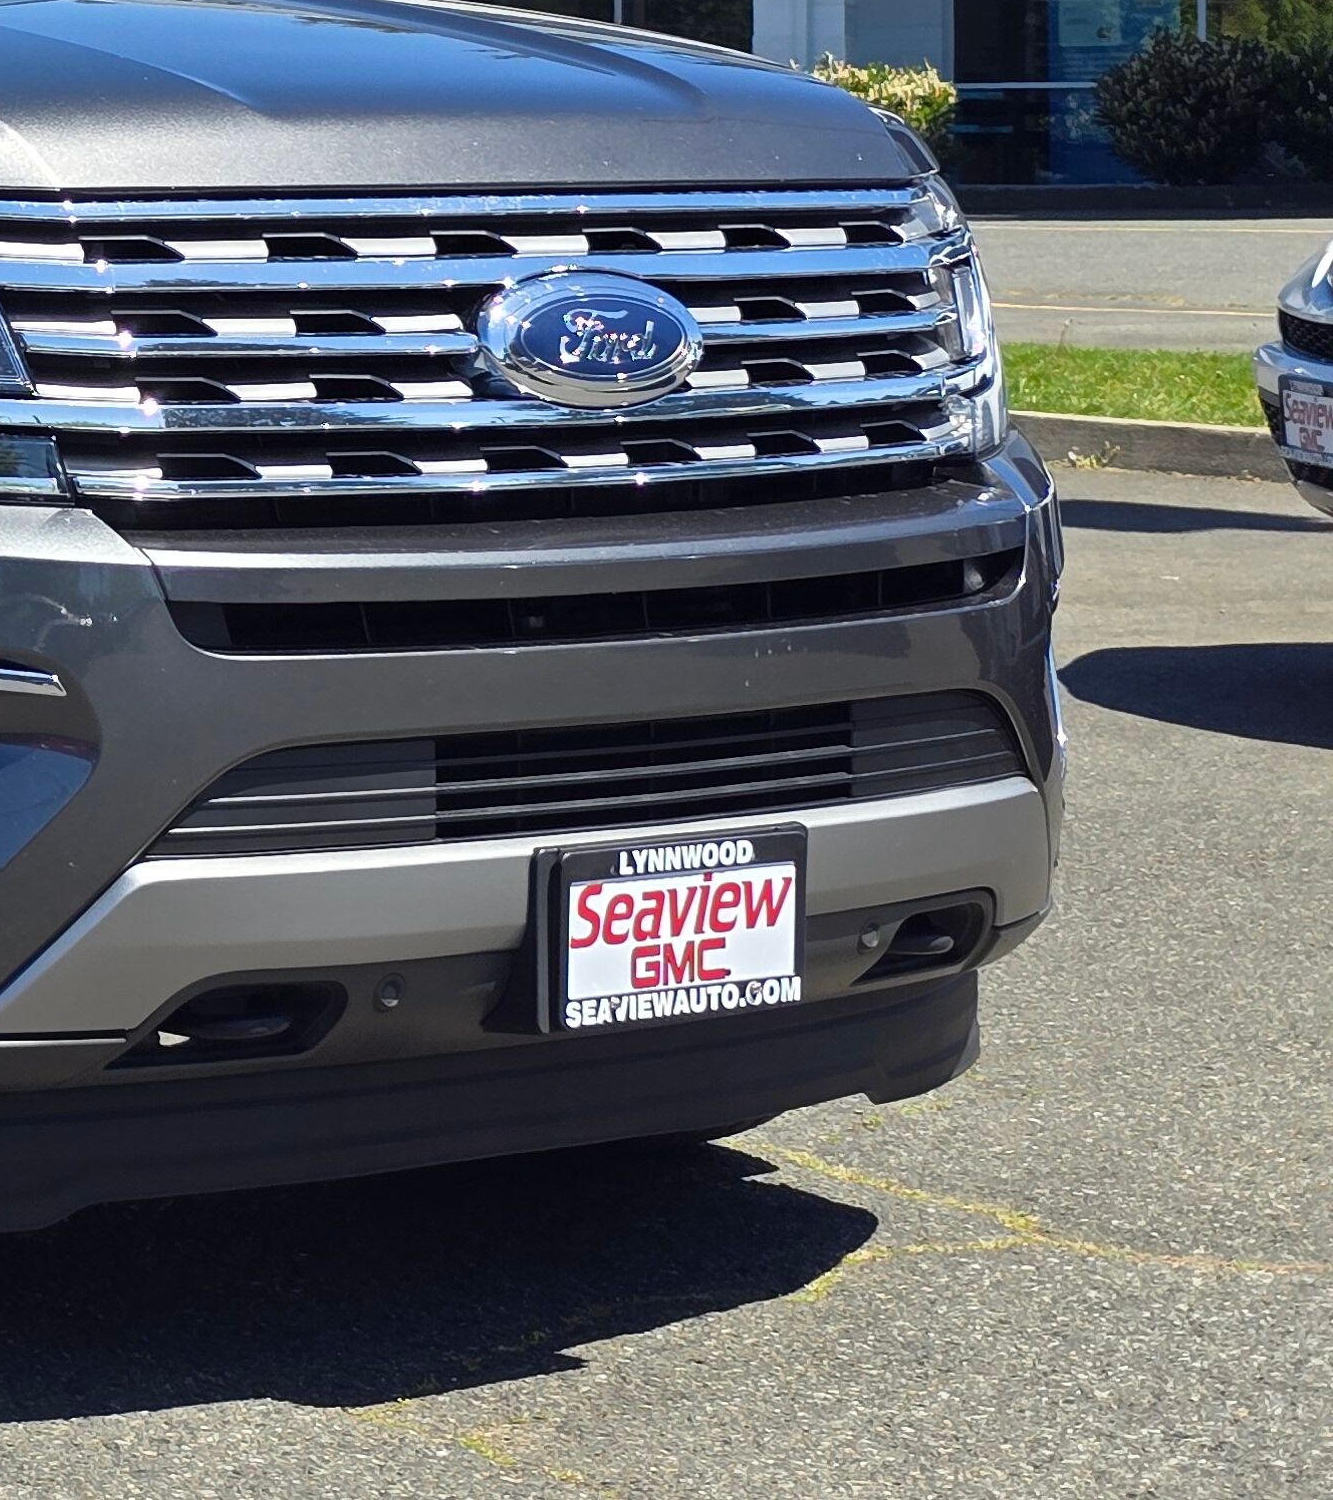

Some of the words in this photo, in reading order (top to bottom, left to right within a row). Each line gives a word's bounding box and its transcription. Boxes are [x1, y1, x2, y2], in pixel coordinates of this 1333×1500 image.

[559, 308, 657, 364] Ford
[619, 839, 755, 876] LYNNWOOD
[569, 871, 793, 949] Seaview
[630, 937, 729, 989] GMC
[565, 975, 802, 1029] SEAVIEWAUTO.COM
